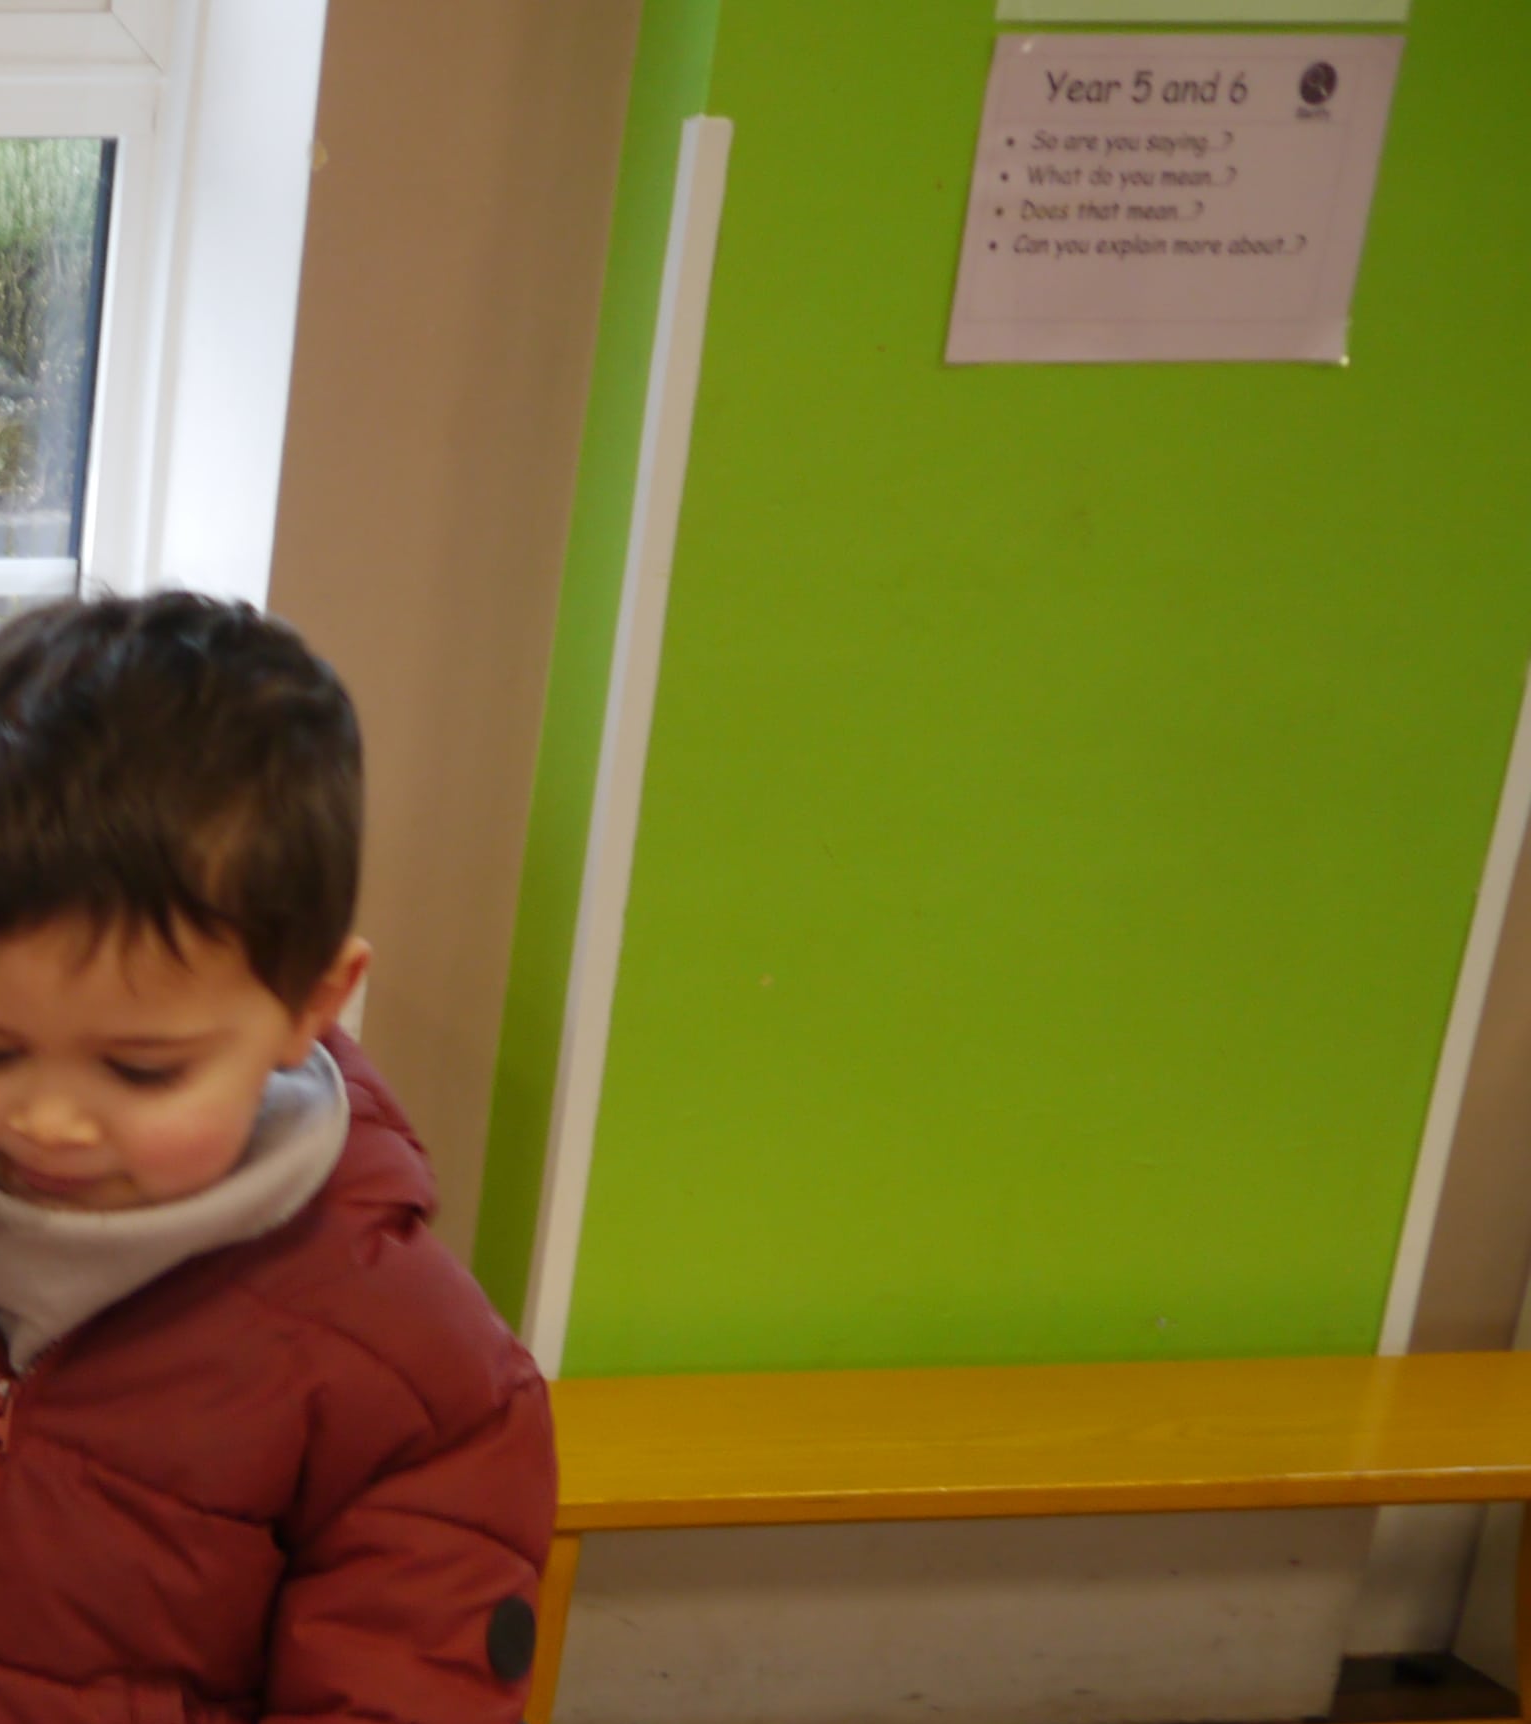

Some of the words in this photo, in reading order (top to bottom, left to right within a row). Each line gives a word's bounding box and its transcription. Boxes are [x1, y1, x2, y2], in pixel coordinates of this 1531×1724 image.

[1045, 70, 1122, 103] Year
[1131, 70, 1154, 103] 5
[1163, 71, 1221, 103] and
[1230, 71, 1247, 104] 6
[1030, 129, 1058, 150] So
[1064, 135, 1099, 150] are
[1105, 136, 1140, 157] you
[1027, 165, 1081, 185] What
[1090, 165, 1114, 186] do
[1120, 171, 1155, 191] you
[1020, 199, 1068, 221] Does
[1078, 200, 1119, 220] that
[1013, 233, 1049, 254] Can
[1055, 239, 1089, 260] you
[1096, 233, 1166, 260] explain
[1172, 239, 1222, 255] more
